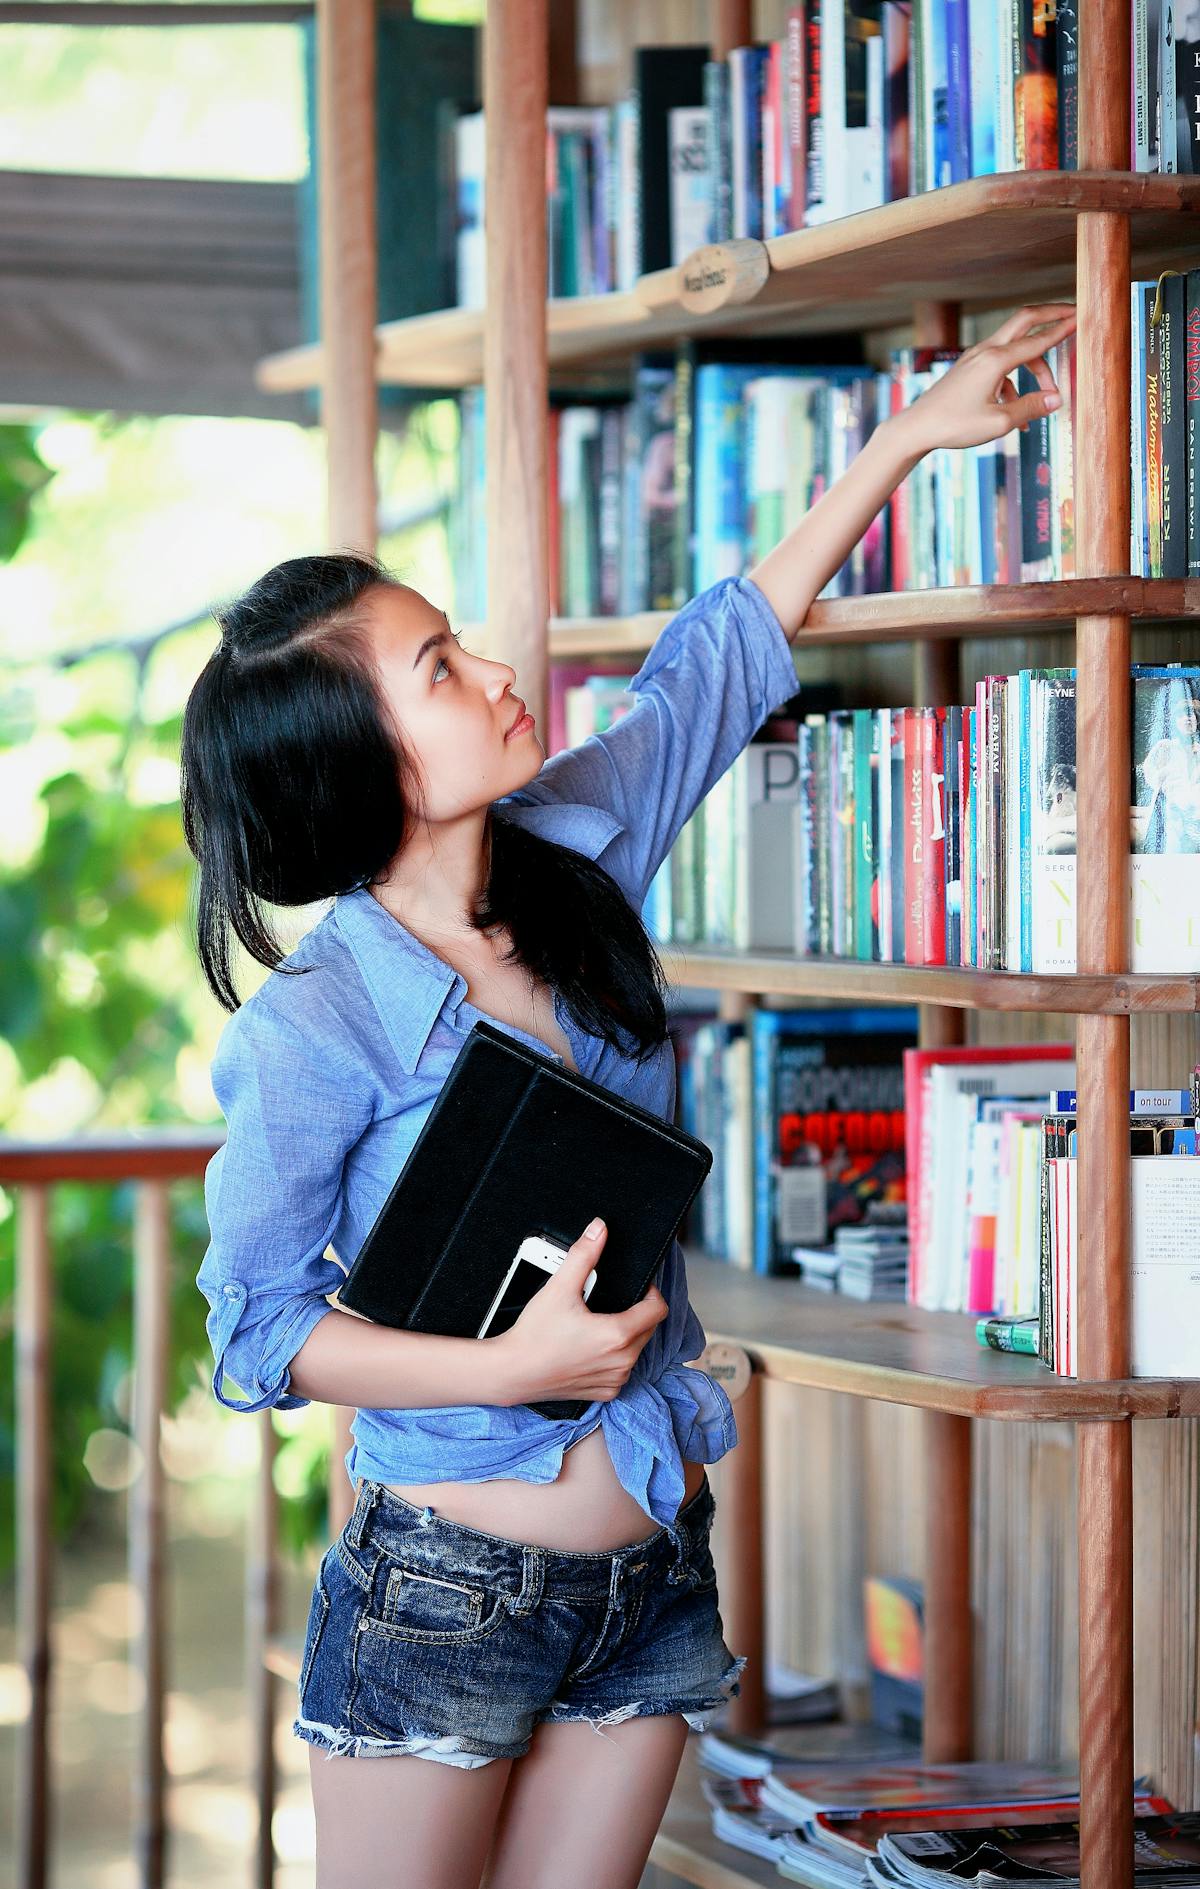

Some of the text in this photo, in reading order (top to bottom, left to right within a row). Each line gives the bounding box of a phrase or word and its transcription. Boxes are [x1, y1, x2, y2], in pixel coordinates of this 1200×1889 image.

[1024, 836, 1032, 905] SPARKS
[1045, 864, 1074, 872] SERG
[1069, 1098, 1077, 1106] P
[1140, 1096, 1172, 1106] on tour
